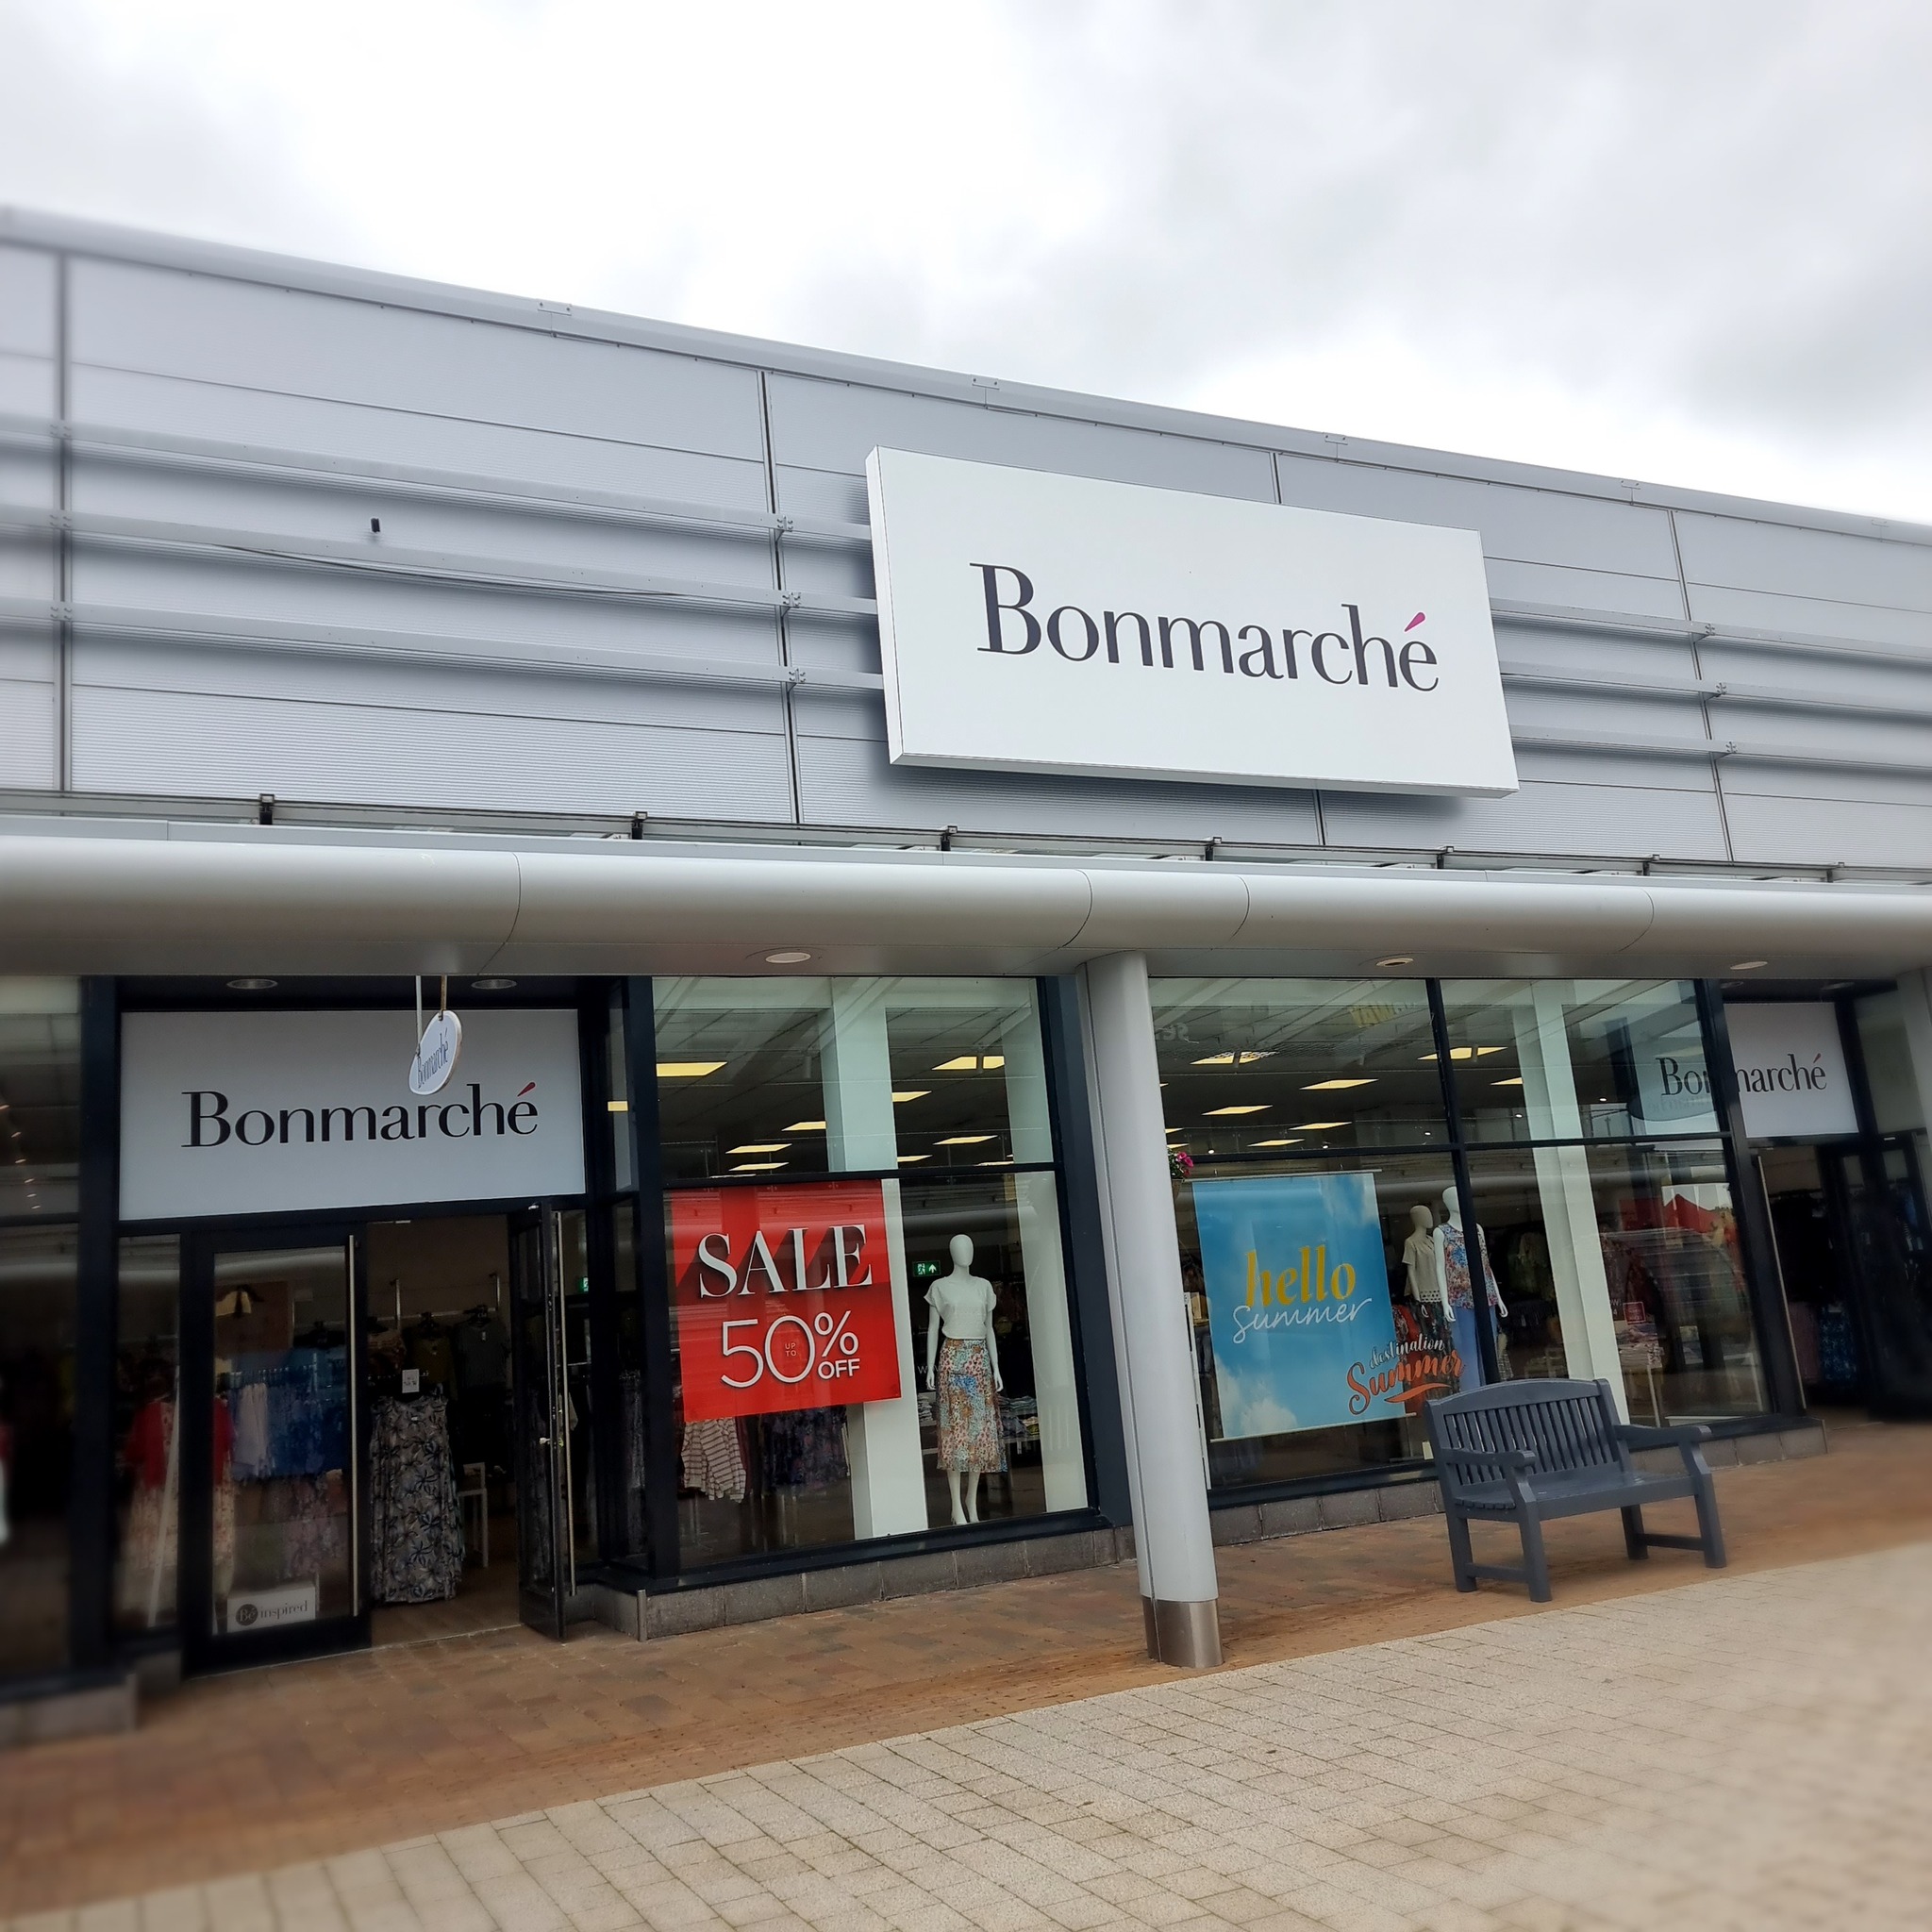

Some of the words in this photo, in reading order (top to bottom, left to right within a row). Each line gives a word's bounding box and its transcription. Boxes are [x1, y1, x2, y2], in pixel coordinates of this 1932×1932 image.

[969, 562, 1439, 691] Bonmarché
[180, 1081, 539, 1148] Bonmarché
[697, 1224, 874, 1298] SALE
[1243, 1243, 1357, 1307] hello
[721, 1310, 859, 1388] 50%
[784, 1341, 796, 1350] UP
[785, 1349, 797, 1357] TO
[817, 1357, 860, 1380] OFF
[1346, 1349, 1464, 1415] Summer
[260, 1600, 308, 1620] inspired
